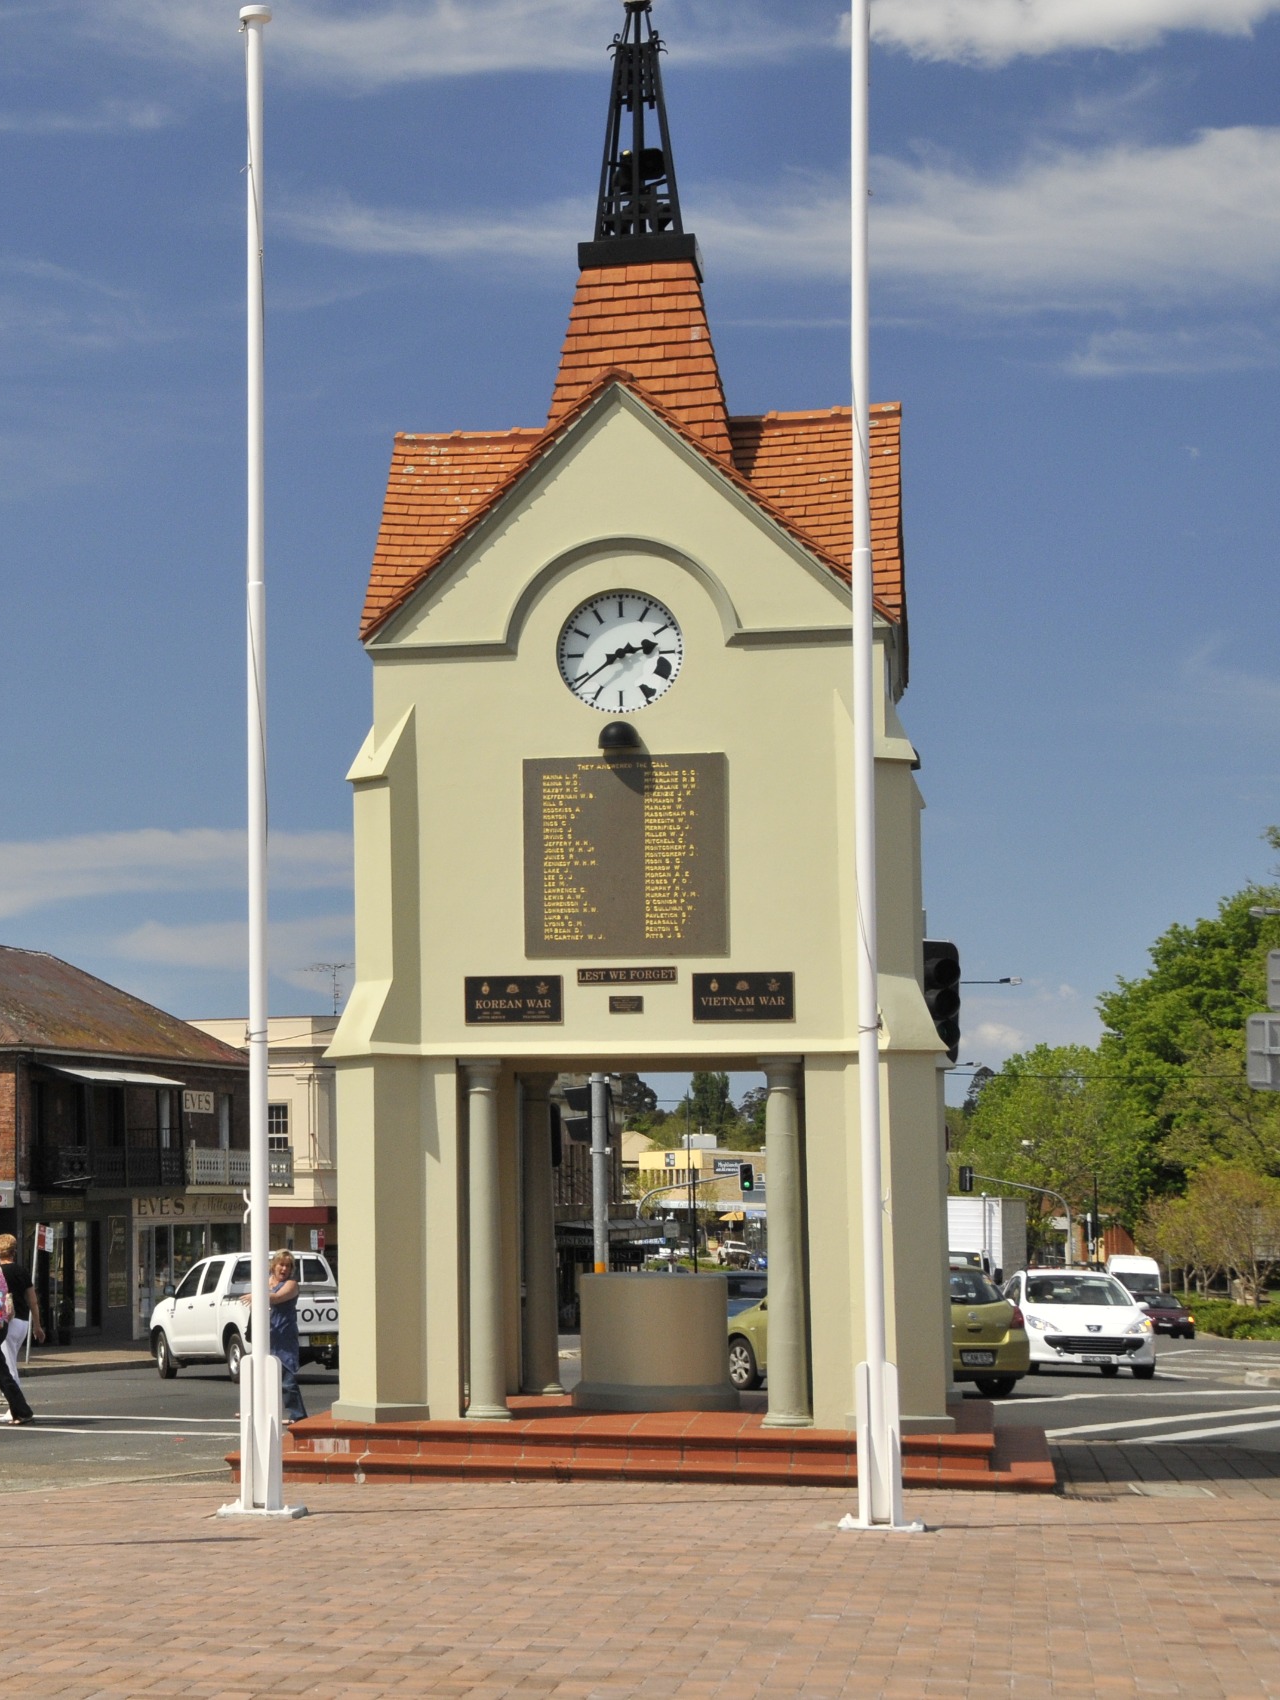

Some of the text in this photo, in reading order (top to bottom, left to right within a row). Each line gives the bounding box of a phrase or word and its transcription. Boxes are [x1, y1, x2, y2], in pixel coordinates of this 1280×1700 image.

[579, 969, 675, 980] LEST WE FORGET
[475, 999, 551, 1009] KOREAN WAR
[701, 996, 785, 1006] VIETNAM WAR
[184, 1093, 211, 1111] EVE'S
[137, 1197, 185, 1216] EVE'S
